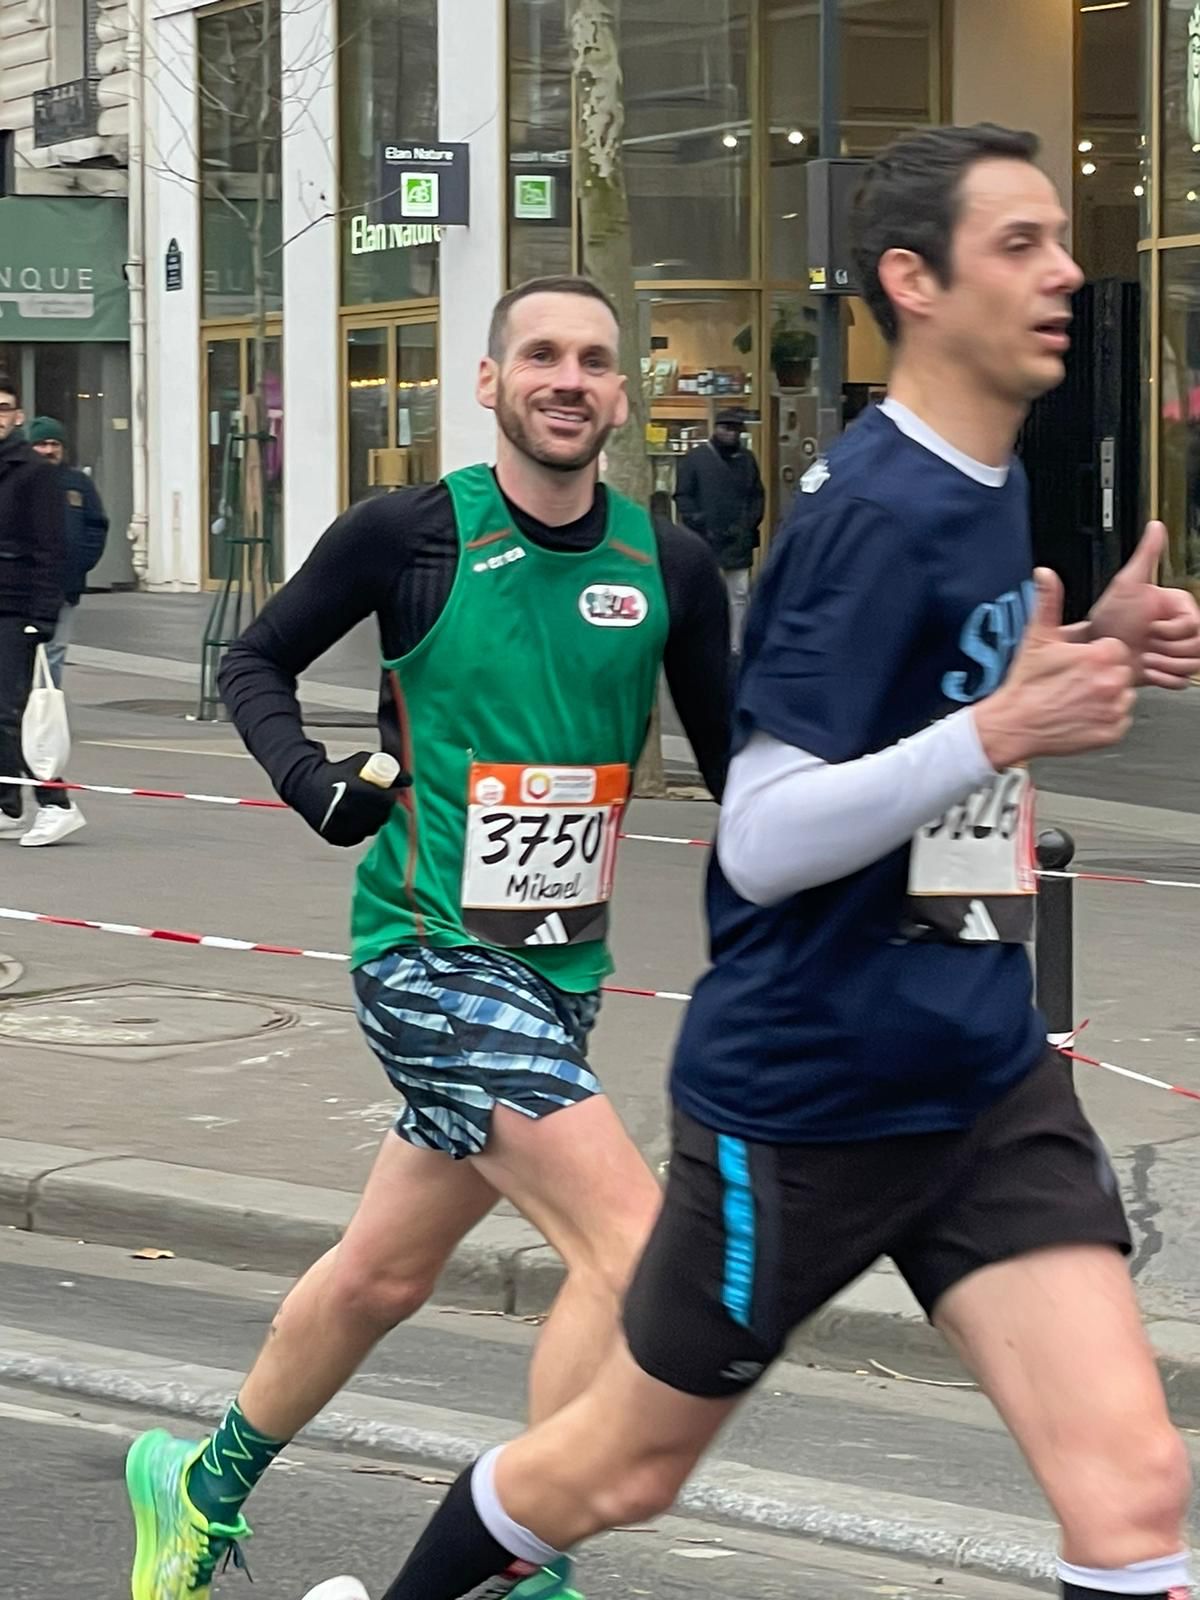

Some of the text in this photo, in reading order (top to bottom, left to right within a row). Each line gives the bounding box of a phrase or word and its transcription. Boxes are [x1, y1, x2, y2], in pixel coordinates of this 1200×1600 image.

[385, 146, 454, 160] Elan Nature
[351, 215, 386, 255] Elan
[480, 811, 604, 868] 3750
[505, 872, 584, 902] Mikael
